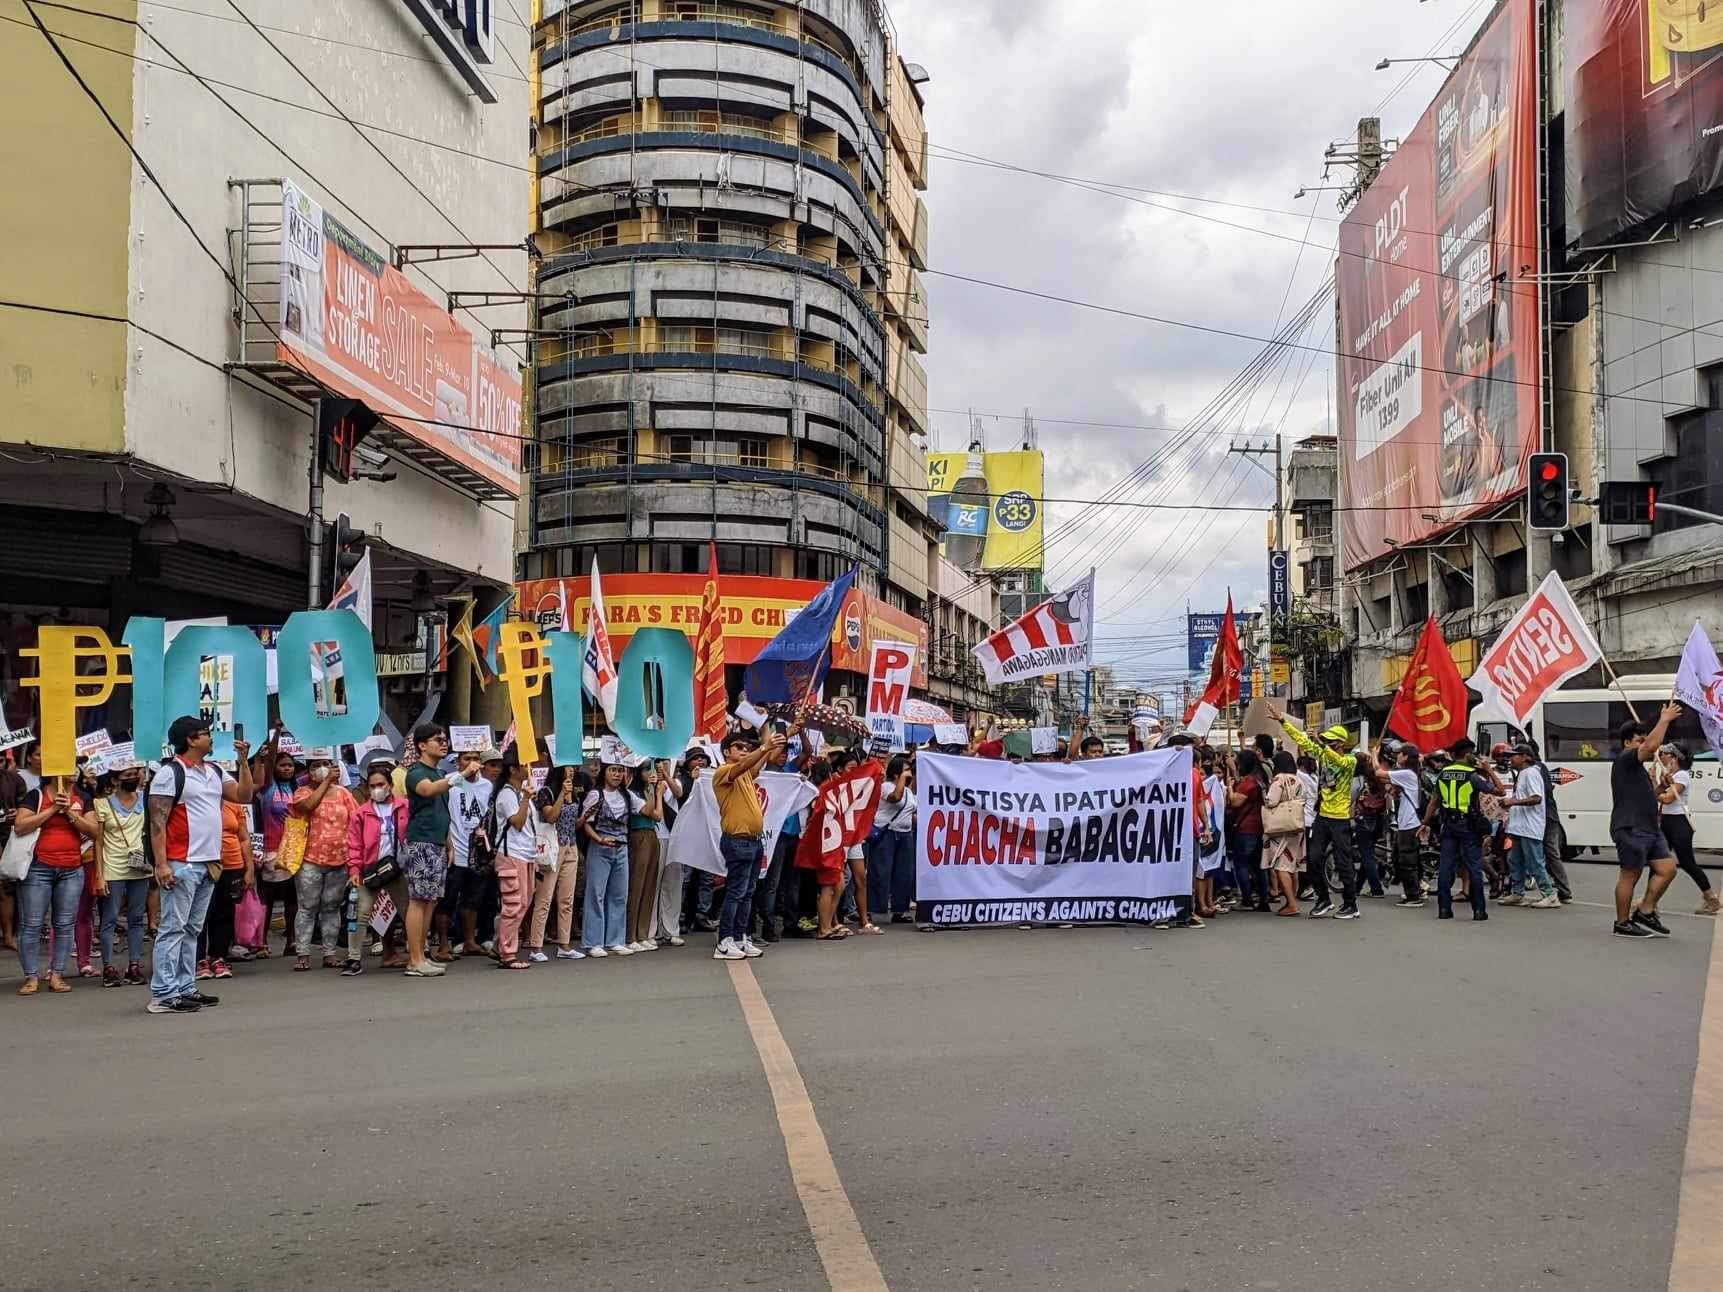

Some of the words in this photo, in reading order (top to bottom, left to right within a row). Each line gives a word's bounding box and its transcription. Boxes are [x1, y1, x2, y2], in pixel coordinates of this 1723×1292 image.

[289, 210, 319, 258] METRO
[1375, 185, 1409, 258] PLDT
[336, 261, 375, 326] LINEN
[1355, 331, 1373, 353] HAVE
[1372, 324, 1380, 339] IT
[1379, 312, 1392, 334] ALL
[1400, 277, 1422, 308] HOME
[328, 306, 381, 375] STORAGE
[381, 295, 435, 407] SALE
[1359, 388, 1383, 418] Fiber
[1384, 369, 1402, 396] Unli
[1402, 350, 1416, 382] All
[1378, 398, 1399, 431] 1399
[928, 460, 948, 476] KI
[928, 785, 1046, 814] HUSTISYA
[1054, 782, 1187, 812] IPATUMAN!
[927, 809, 1037, 866] CHACHA
[1044, 808, 1185, 866] BABAGAN!
[931, 902, 973, 923] CEBU
[975, 901, 1048, 923] CITIZEN'S
[1048, 900, 1111, 921] AGAINTS
[1113, 900, 1177, 921] CHACHA
